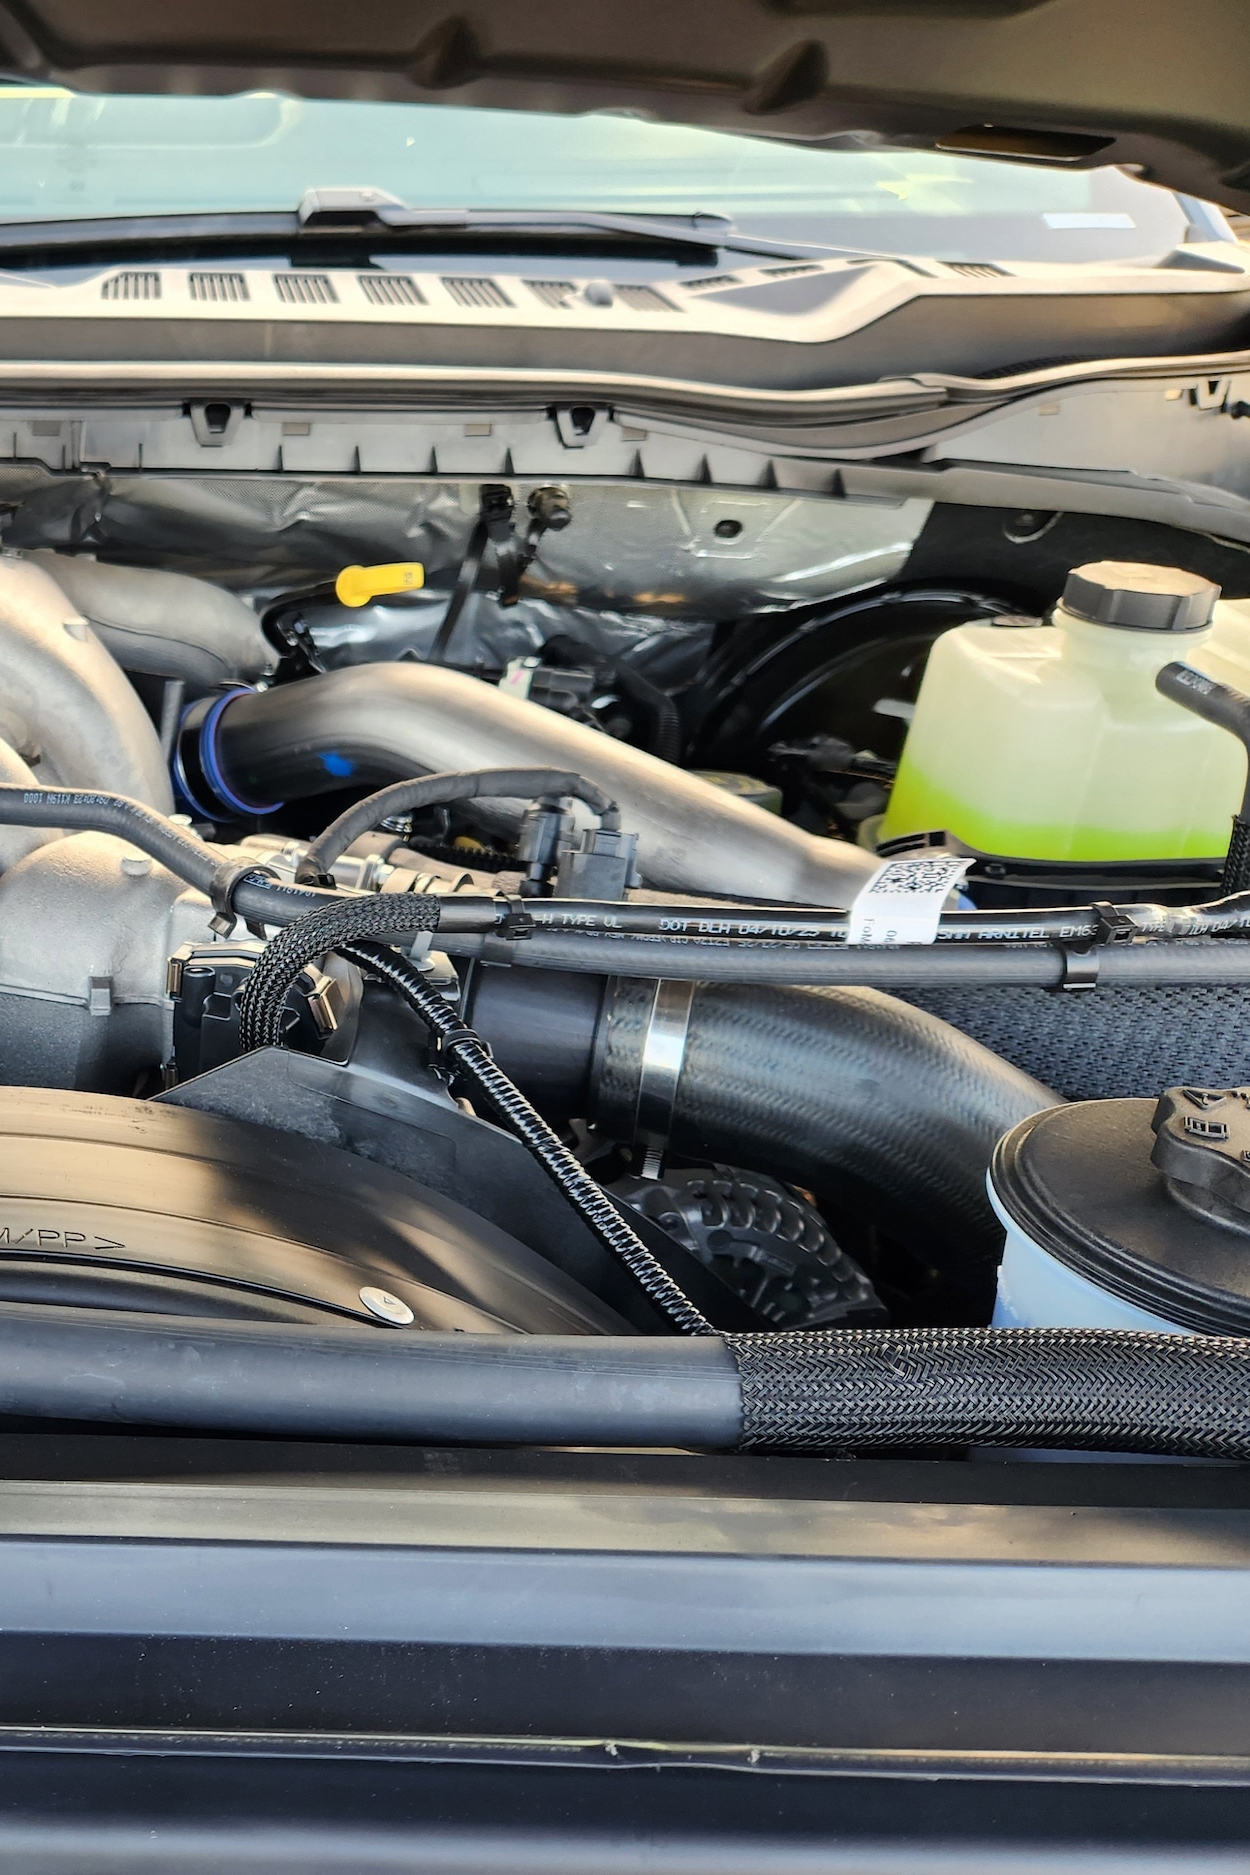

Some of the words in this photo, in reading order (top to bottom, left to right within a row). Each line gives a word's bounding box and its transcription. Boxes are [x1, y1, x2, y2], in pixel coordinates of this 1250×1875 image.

[561, 913, 598, 926] TYPE
[659, 919, 690, 932] DOT
[978, 927, 1050, 939] ARNITEL
